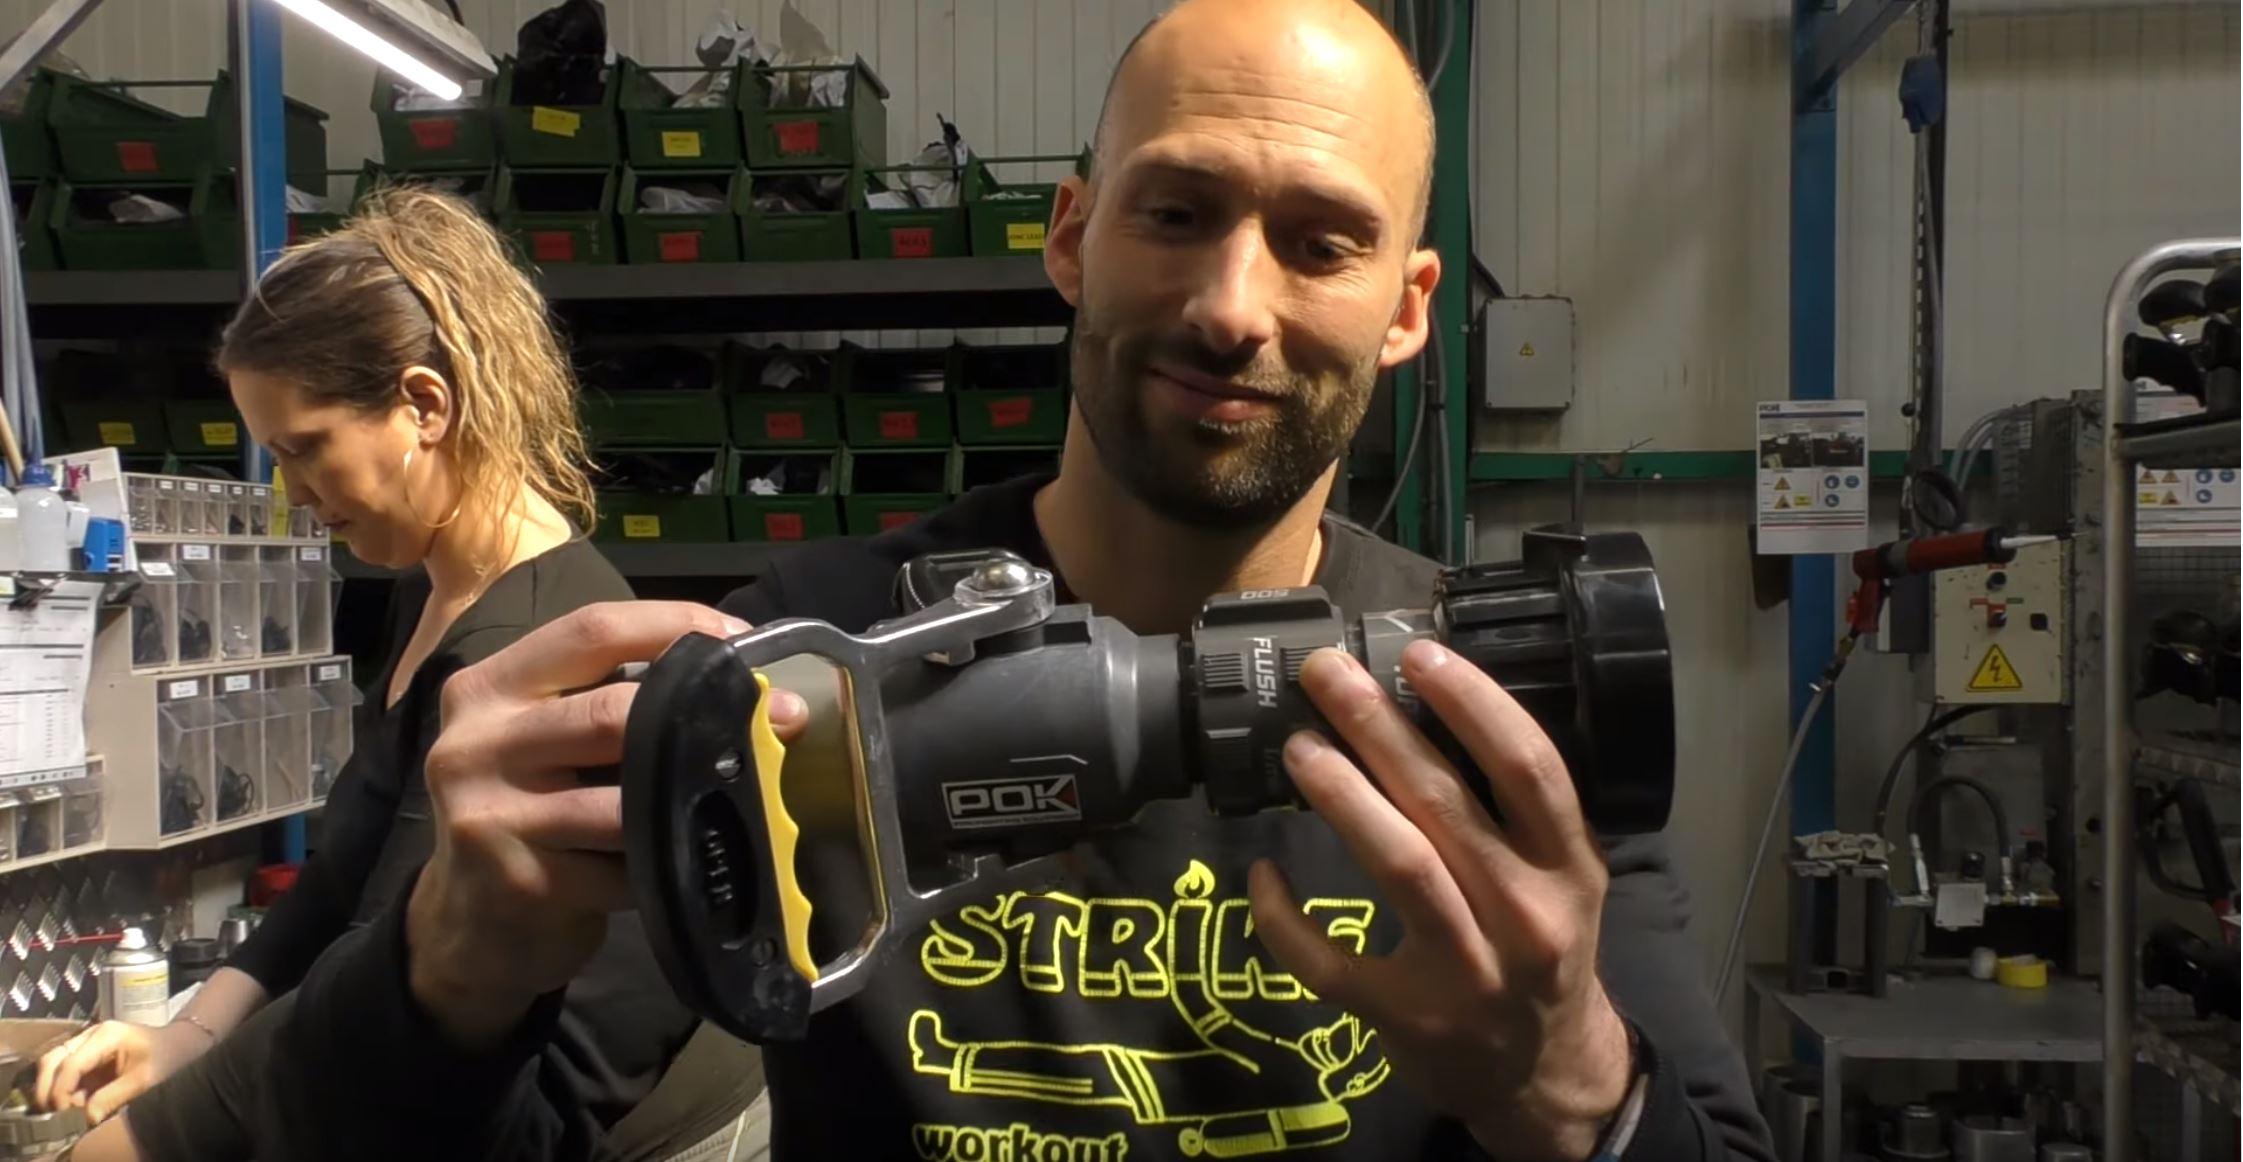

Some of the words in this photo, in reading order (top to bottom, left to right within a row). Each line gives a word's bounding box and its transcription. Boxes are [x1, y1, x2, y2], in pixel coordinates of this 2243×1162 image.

[1240, 589, 1289, 600] 500
[1253, 637, 1277, 708] FLUSH
[950, 775, 1081, 815] POK
[912, 1123, 1128, 1162] workout
